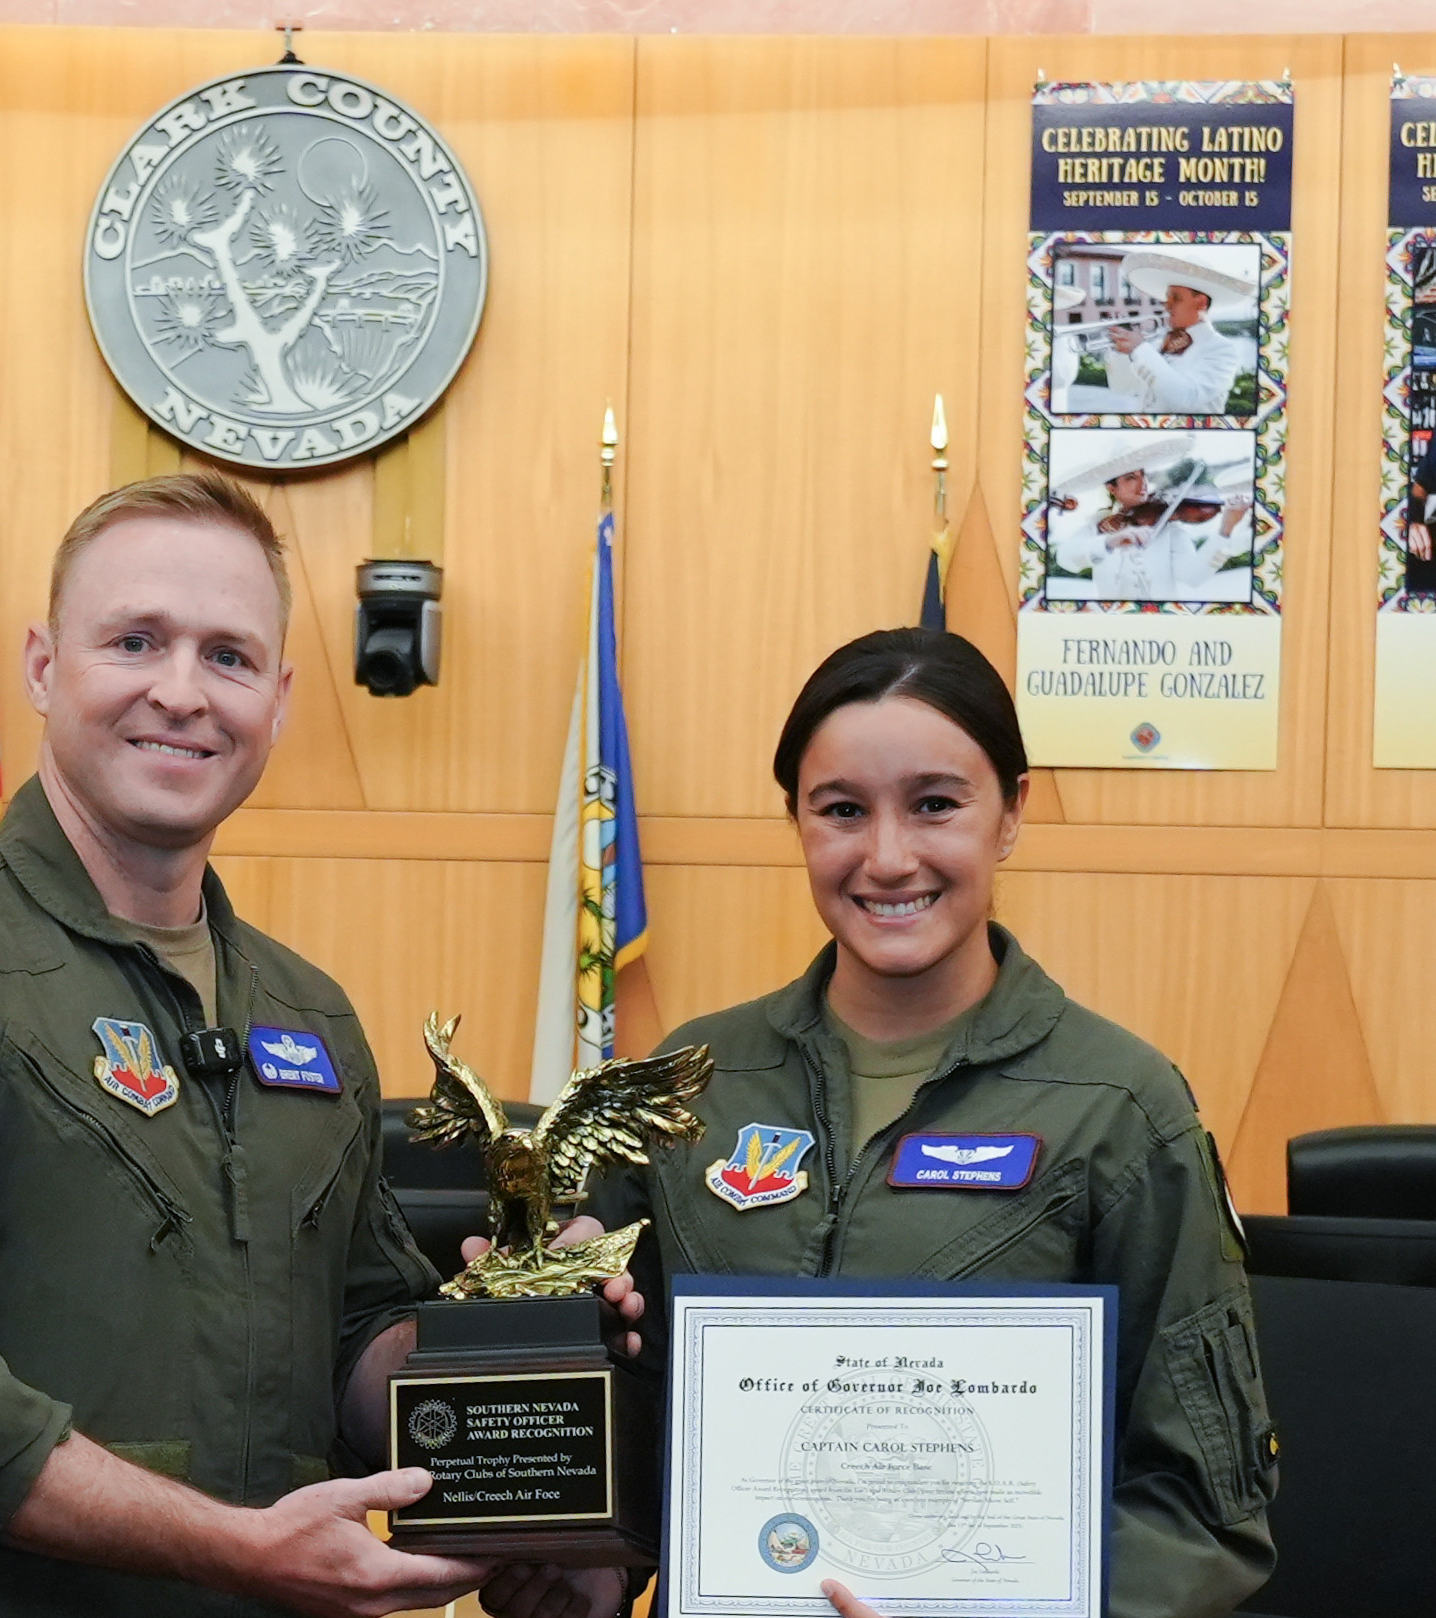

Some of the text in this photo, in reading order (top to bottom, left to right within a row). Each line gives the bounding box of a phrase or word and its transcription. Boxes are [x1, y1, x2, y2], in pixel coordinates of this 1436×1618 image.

[1041, 126, 1283, 153] CELEBRATING LATINO
[92, 73, 479, 261] CLARK COUNTY
[1058, 157, 1266, 183] HERITAGE MONTH!
[1063, 190, 1259, 207] SEPTEMBER 15 OCTOBER 15
[151, 386, 424, 461] NEVADA
[1062, 639, 1233, 667] FERNANDO AND
[1027, 670, 1265, 700] GUADALUPE GONZALEZ
[104, 1076, 119, 1091] AIR
[916, 1170, 1001, 1181] CAROL STEPHENS
[751, 1185, 796, 1203] COMMAND
[835, 1355, 944, 1370] State of Nevada
[738, 1377, 1037, 1398] Office of Governor Joe Lombardo
[466, 1402, 580, 1415] SOUTHERN NEVADA
[800, 1405, 975, 1415] CERTIFICATE OF RECOGNITION
[466, 1415, 565, 1428] SAFETY OFFICER
[467, 1426, 594, 1440] AWARD RECOGNITION
[801, 1441, 975, 1453] CAPTAIN CAROL STEPHENS
[430, 1453, 572, 1468] Perpetual Trophy Presented by
[431, 1465, 597, 1483] Rotary Clubs of Southern Nevada
[442, 1489, 561, 1503] Nellis/Creech Air Foce
